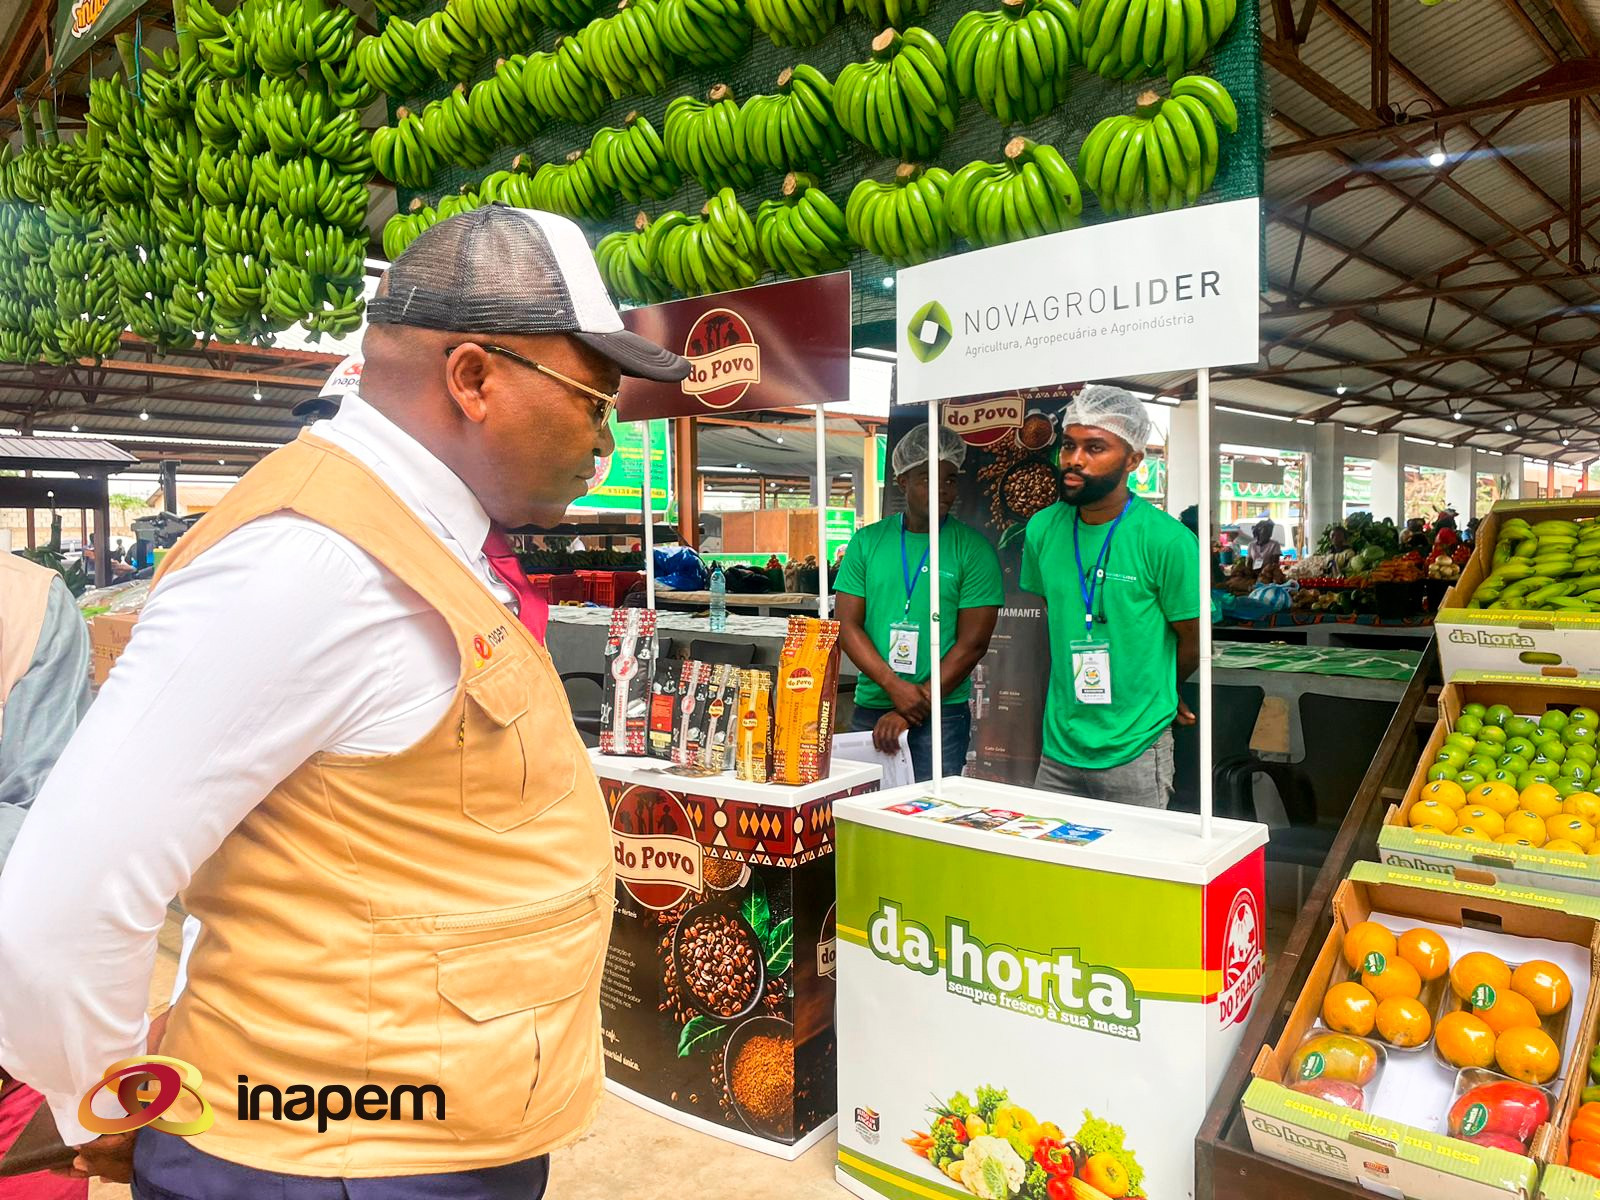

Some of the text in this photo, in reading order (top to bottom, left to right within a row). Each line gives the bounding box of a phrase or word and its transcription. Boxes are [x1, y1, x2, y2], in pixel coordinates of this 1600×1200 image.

[965, 270, 1220, 335] NOVAGROLIDER
[965, 313, 1194, 359] Agricultura, Agropecuária e Agroindústria
[688, 357, 753, 382] do Povo
[948, 407, 1018, 425] do Povo
[998, 607, 1041, 618] IAMANTE
[1450, 629, 1535, 647] da horta
[614, 841, 694, 875] do Povo
[1413, 856, 1455, 875] hort
[1414, 838, 1462, 851] sempre
[1465, 843, 1505, 857] fresco
[1520, 854, 1546, 864] sua
[1549, 857, 1588, 869] mesa
[1388, 871, 1422, 882] mesa
[1426, 877, 1449, 886] sua
[1464, 883, 1508, 897] fresco
[1511, 890, 1565, 905] sempre
[822, 947, 836, 964] do
[872, 905, 1132, 1019] da horta
[1220, 960, 1261, 1022] DO PRADO
[948, 980, 1138, 1039] sempre fresco à sua mesa
[1252, 1117, 1347, 1161] da horta
[1284, 1098, 1338, 1122] sempre
[1339, 1110, 1387, 1137] fresco
[1403, 1134, 1433, 1151] sua
[1436, 1142, 1481, 1166] mesa
